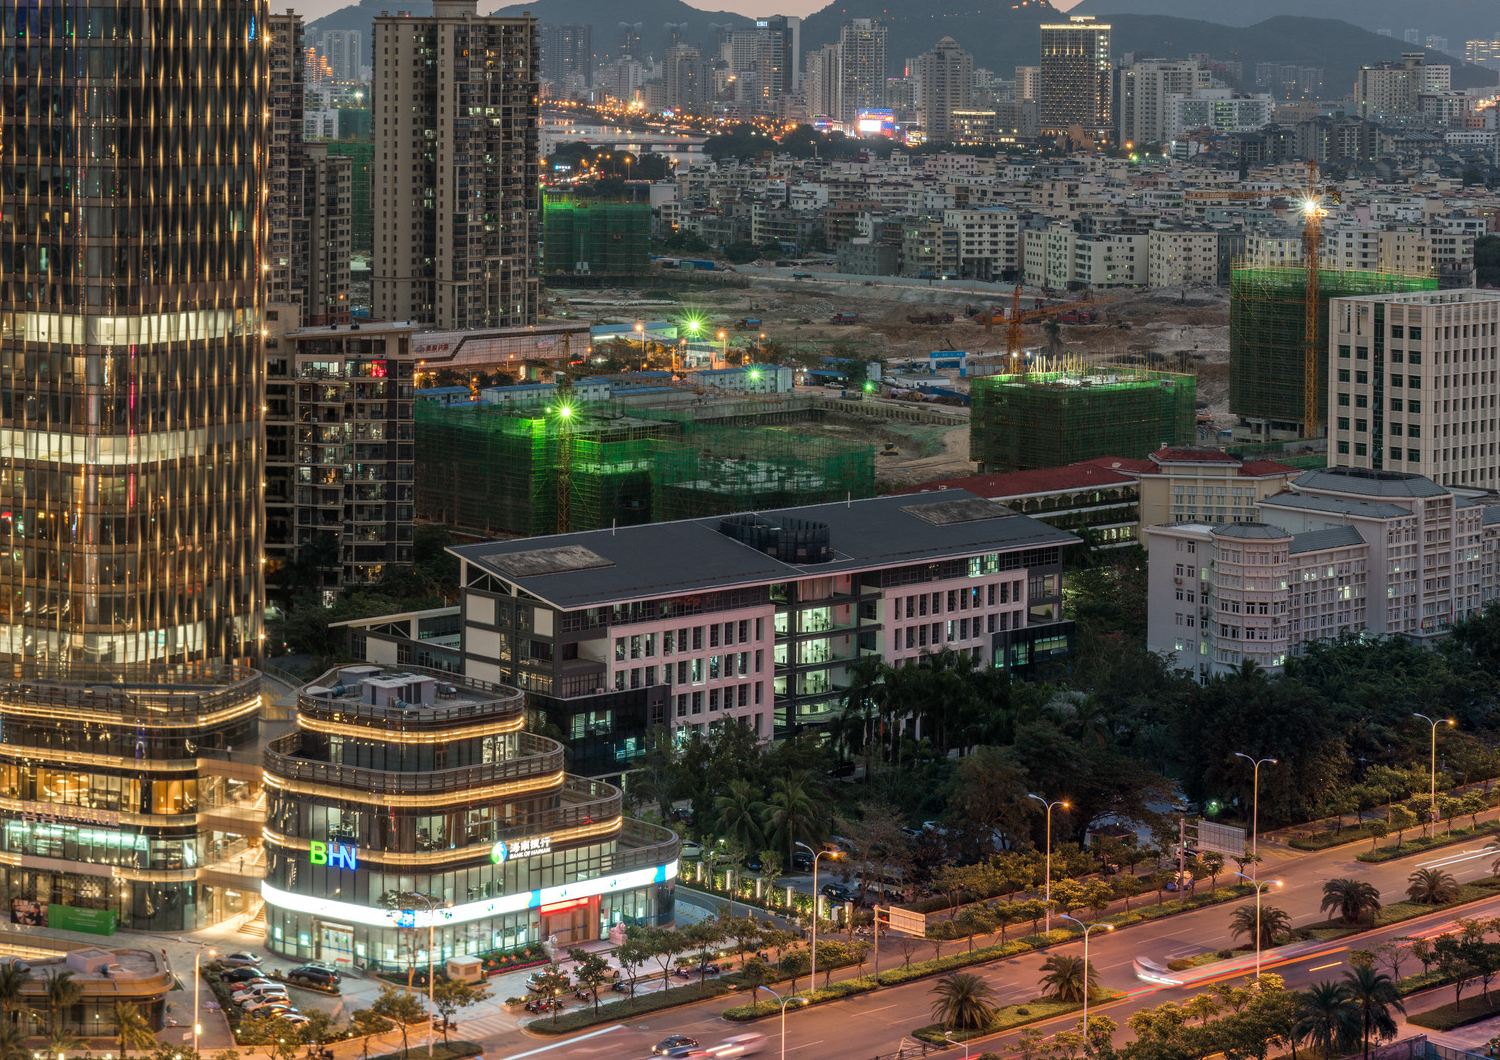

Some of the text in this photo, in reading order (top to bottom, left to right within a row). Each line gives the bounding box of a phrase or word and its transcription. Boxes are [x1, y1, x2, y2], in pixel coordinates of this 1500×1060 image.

[509, 836, 551, 852] 海南银行
[310, 840, 357, 871] BHN
[509, 852, 523, 860] BANK
[531, 847, 551, 856] HAINAN
